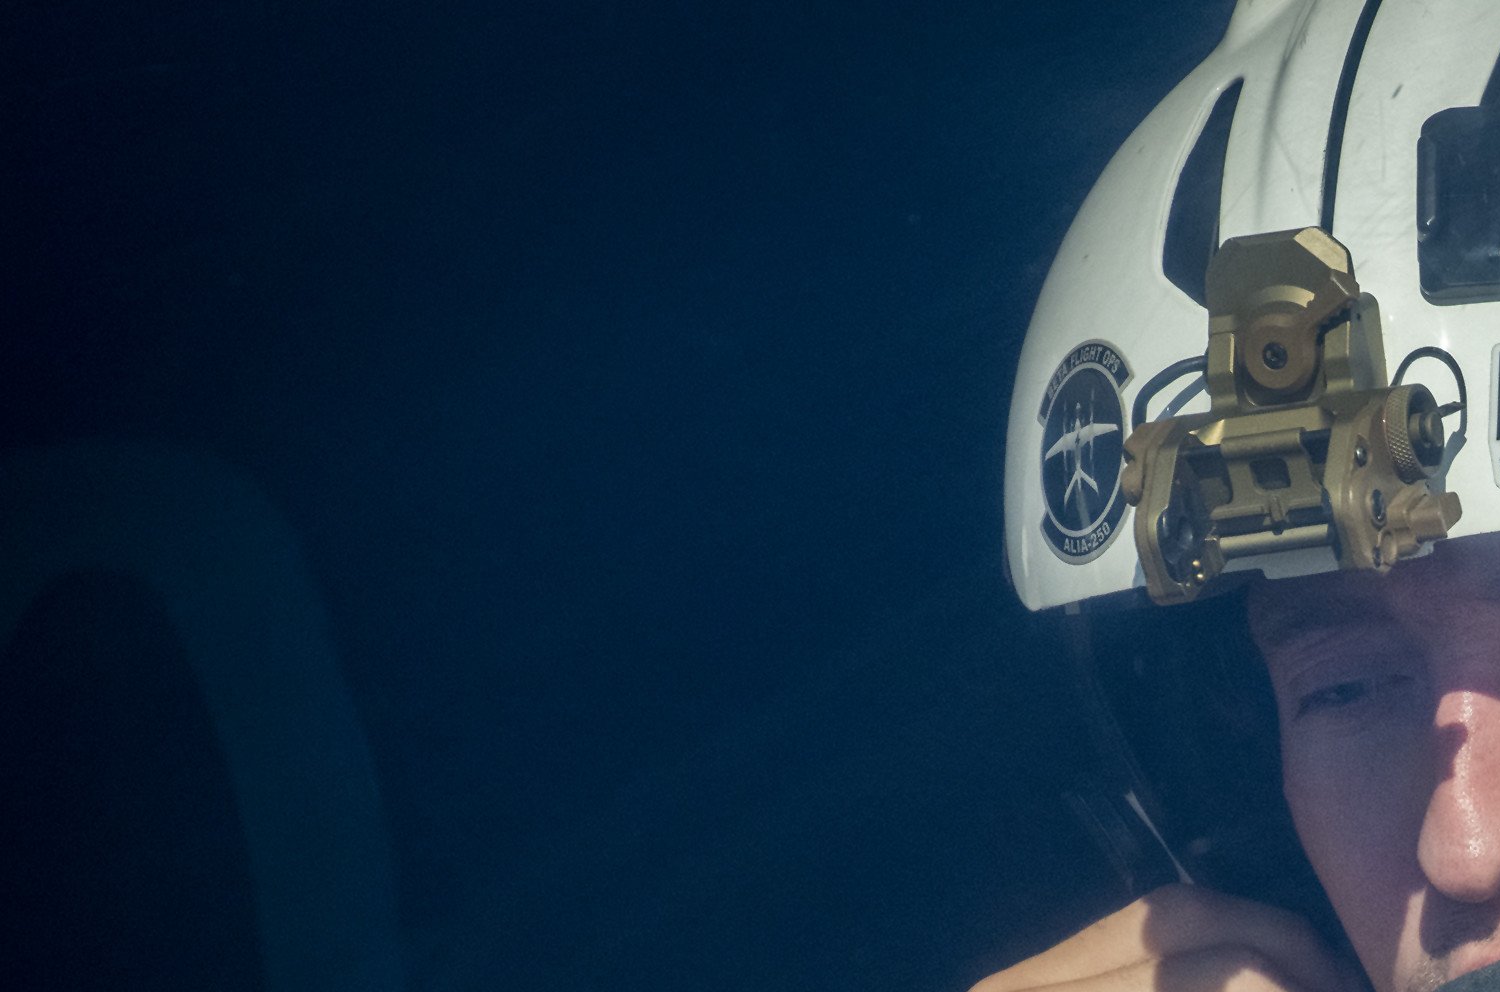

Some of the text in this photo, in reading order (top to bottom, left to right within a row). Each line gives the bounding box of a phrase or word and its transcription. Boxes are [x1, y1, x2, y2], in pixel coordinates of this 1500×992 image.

[1070, 346, 1102, 370] FLIGHT
[1102, 350, 1120, 374] OPS
[1063, 521, 1110, 554] ALIA-250
